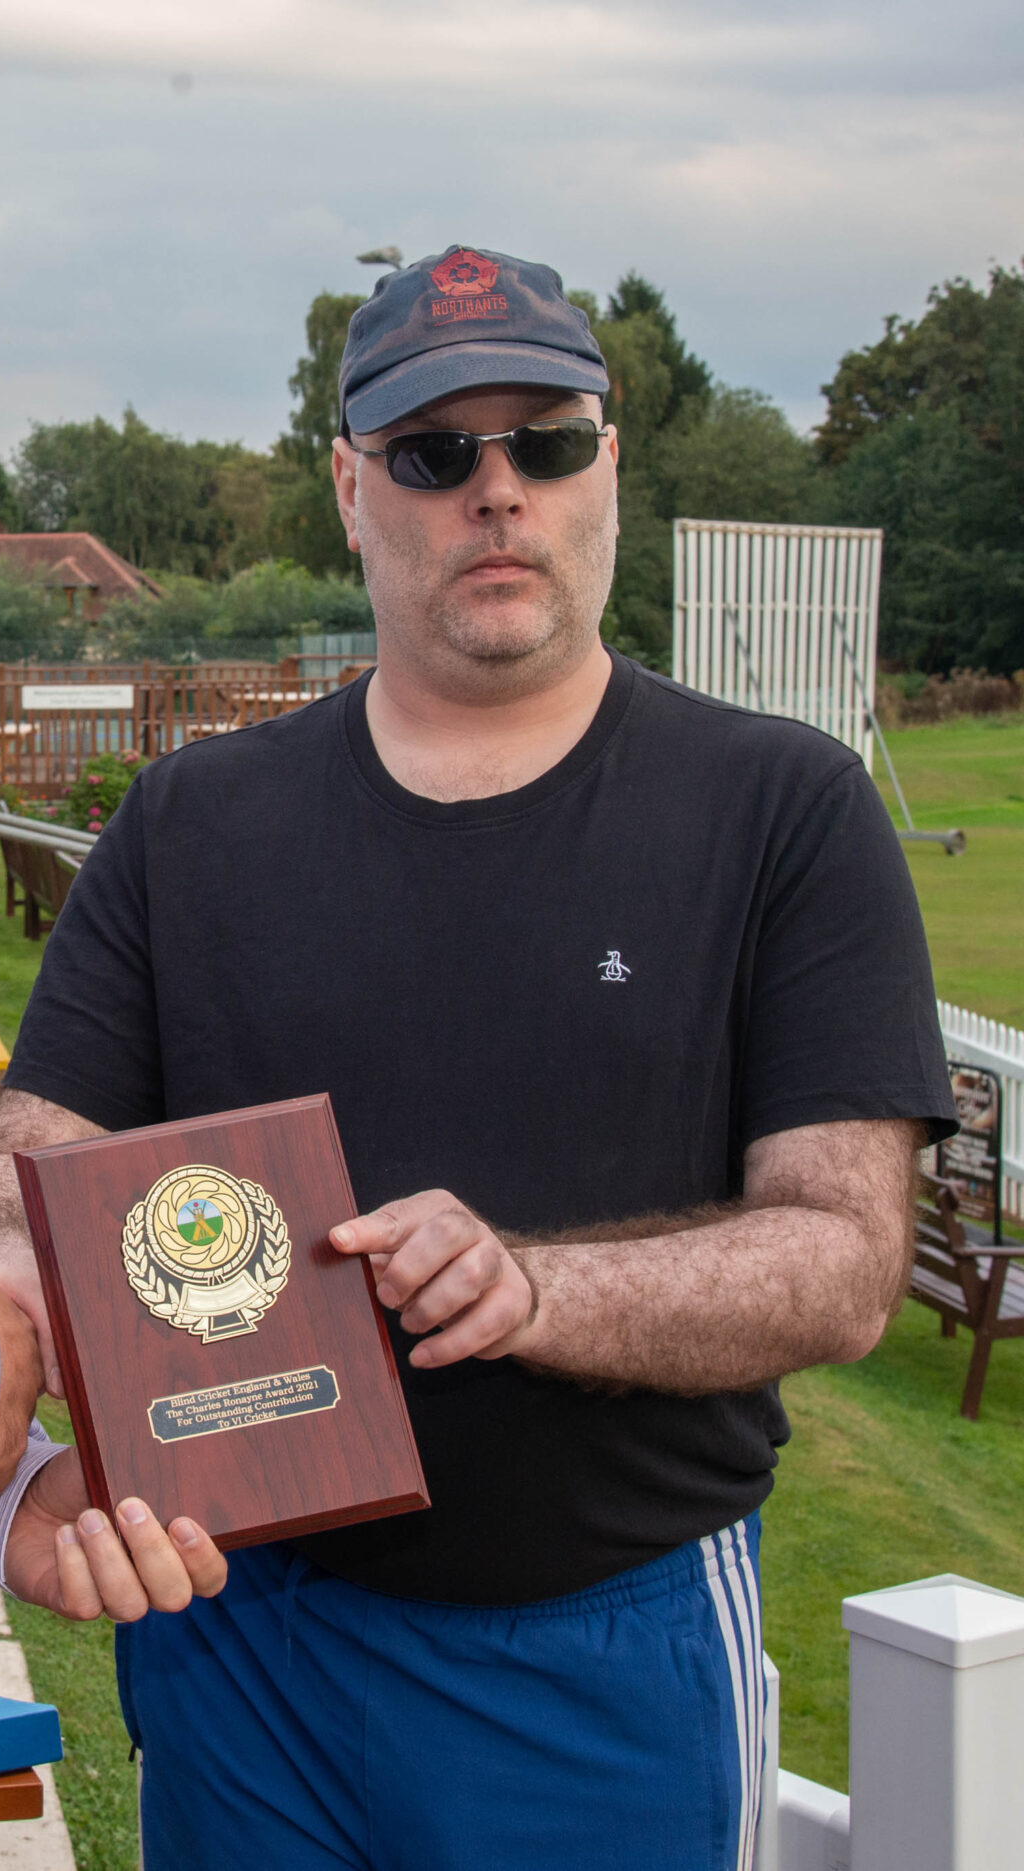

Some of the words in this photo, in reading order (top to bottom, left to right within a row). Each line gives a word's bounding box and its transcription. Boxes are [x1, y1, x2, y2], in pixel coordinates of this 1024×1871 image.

[432, 296, 507, 317] NORTHANTS
[166, 1408, 184, 1420] The
[185, 1400, 221, 1415] Charles
[223, 1393, 263, 1408] Ronayne
[265, 1385, 294, 1398] Award
[296, 1381, 319, 1393] 2021
[170, 1395, 195, 1408] Blind
[197, 1388, 232, 1402] Cricket
[233, 1381, 271, 1396] England
[273, 1378, 282, 1387] &
[283, 1372, 311, 1385] Wales
[177, 1416, 193, 1427] For
[195, 1404, 253, 1423] Outstanding
[254, 1392, 313, 1410] Contribution
[217, 1419, 230, 1429] To
[232, 1416, 243, 1426] VI
[244, 1409, 277, 1424] Cricket
